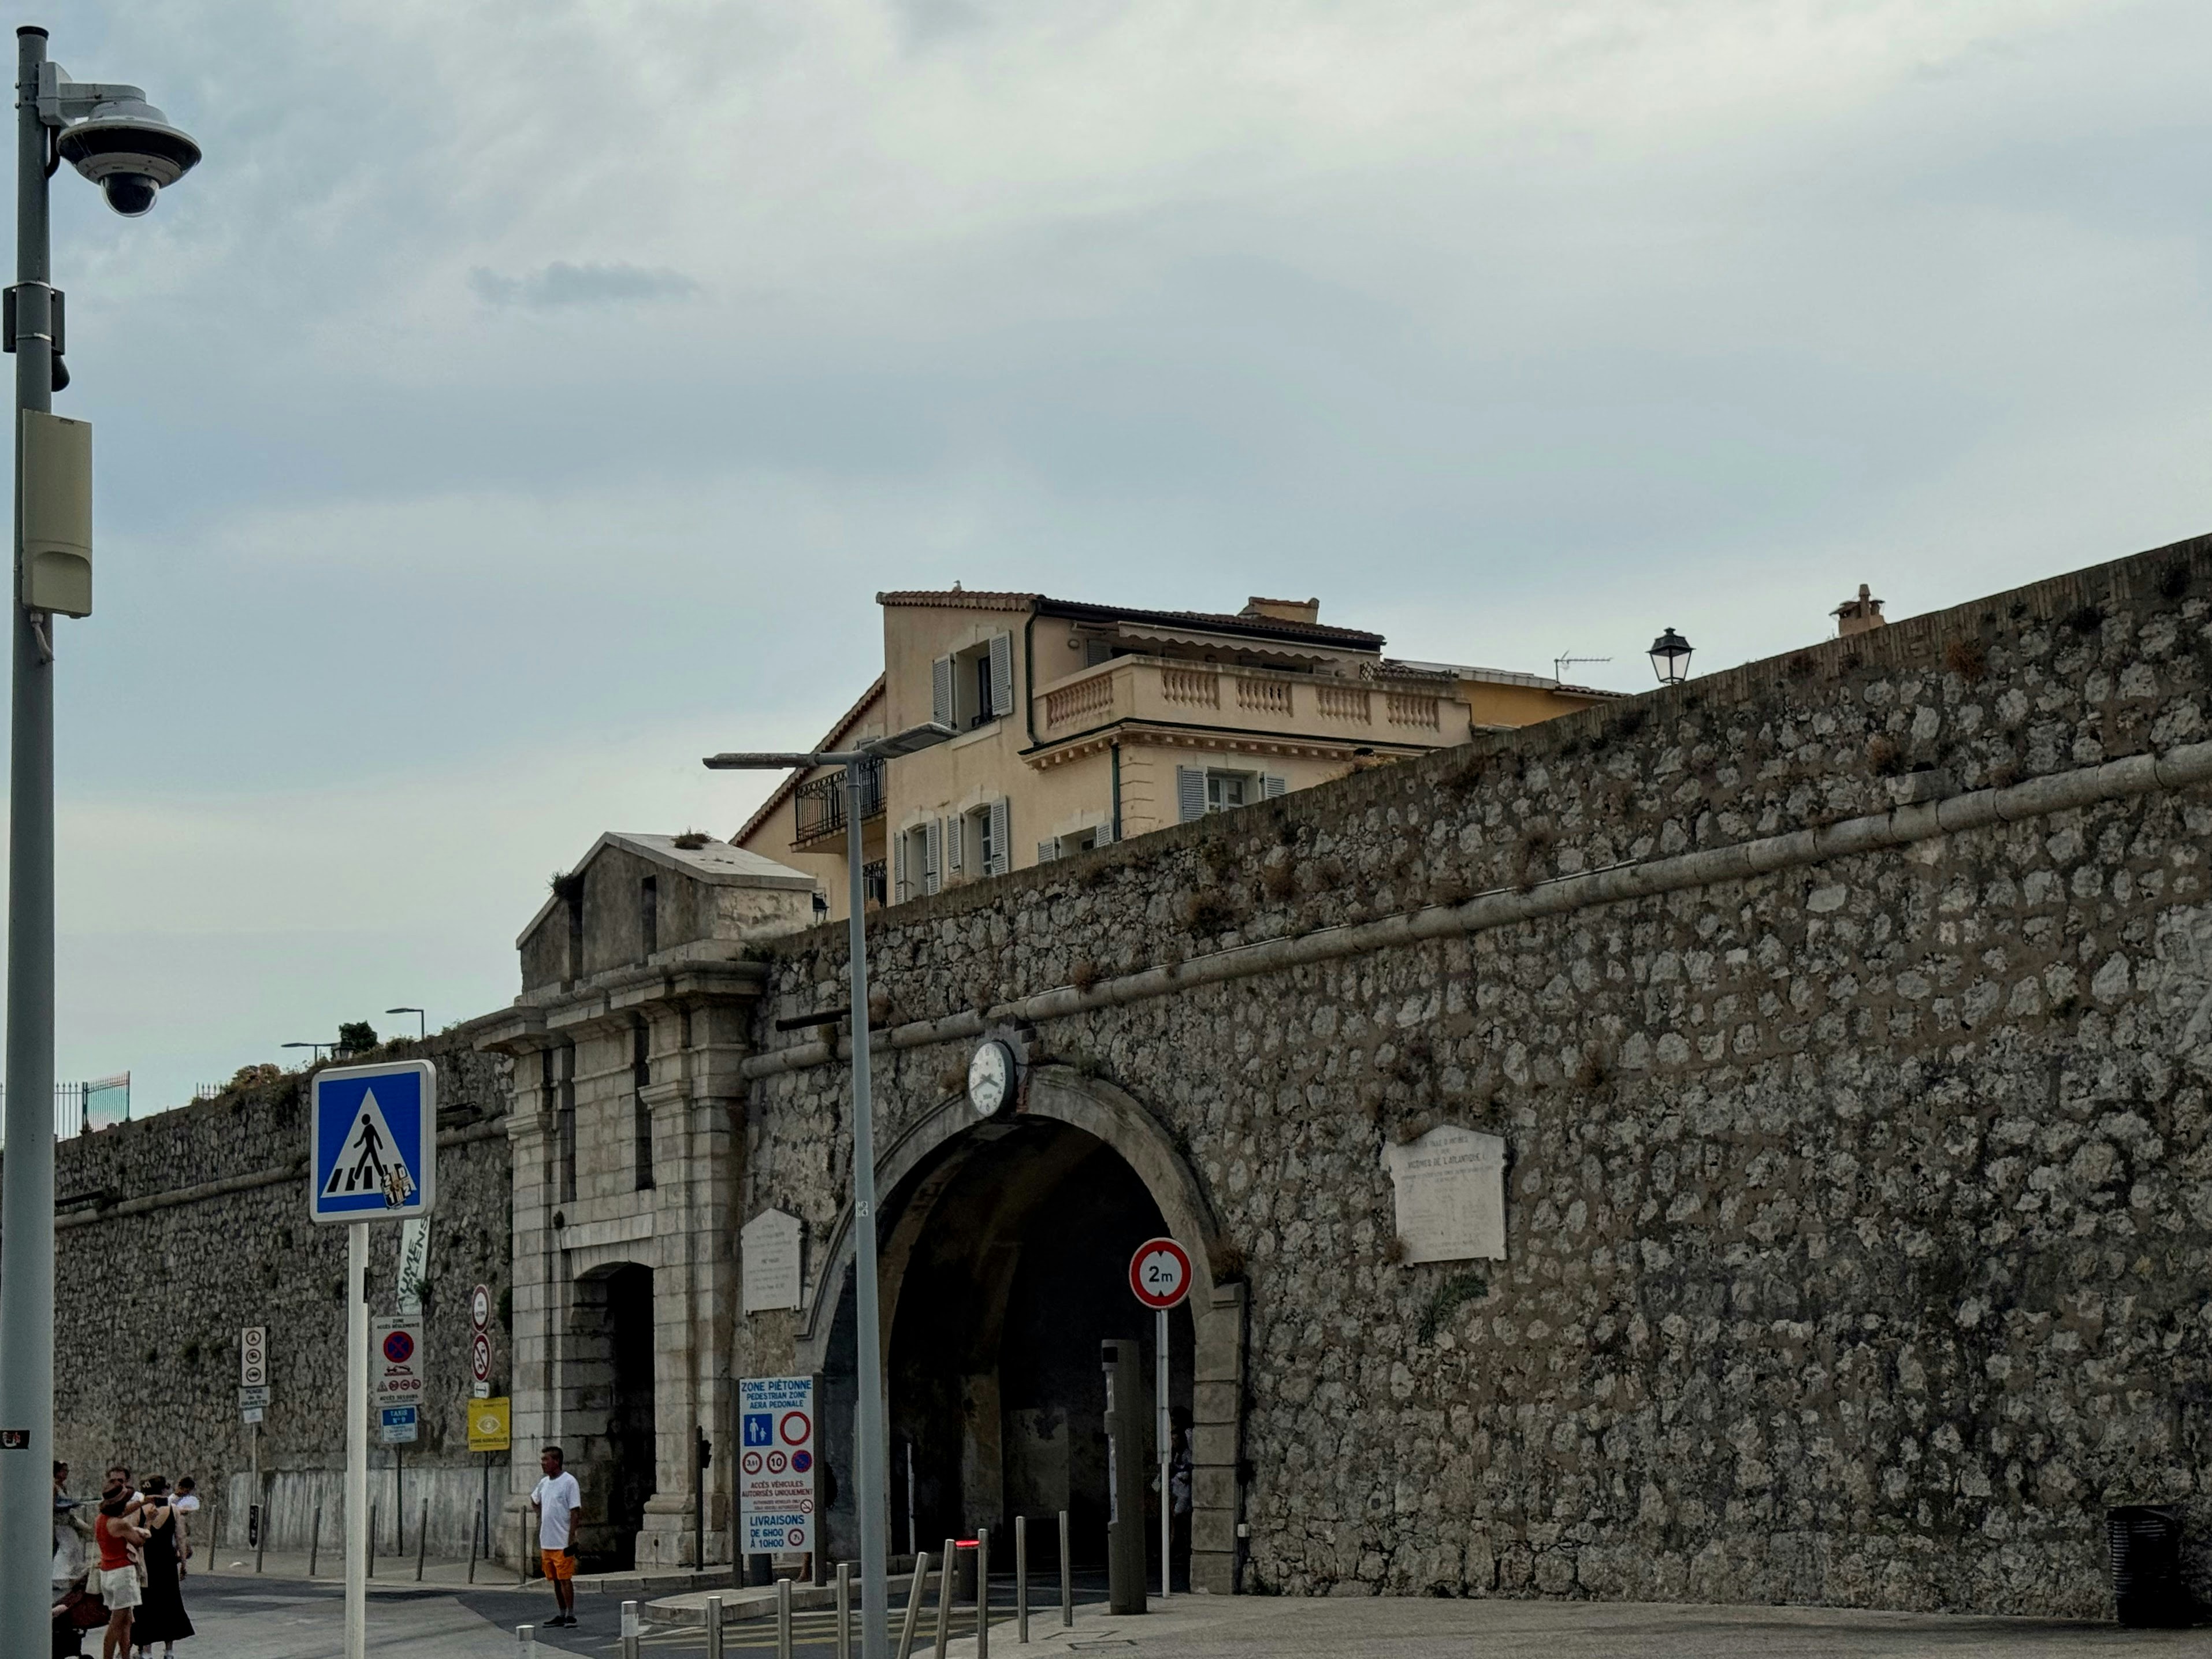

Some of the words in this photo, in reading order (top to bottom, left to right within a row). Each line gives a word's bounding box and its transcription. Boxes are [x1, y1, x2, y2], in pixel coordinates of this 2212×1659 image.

[998, 1057, 1002, 1067] 2
[1000, 1072, 1004, 1082] 3
[979, 1100, 983, 1110] 7
[986, 1103, 990, 1112] 6
[1149, 1266, 1173, 1282] 2m
[742, 1381, 765, 1392] ZONE
[746, 1392, 787, 1400] PEDESTRIAN
[789, 1390, 807, 1398] ZONE
[749, 1401, 767, 1409] AERA
[769, 1399, 804, 1408] PEDONALE
[771, 1457, 782, 1467] 10
[774, 1488, 813, 1496] UNIQUEMENT
[750, 1515, 805, 1526] LIVRAISONS
[750, 1528, 760, 1537] DE
[763, 1528, 783, 1537] 6H00
[750, 1537, 756, 1548] À
[759, 1539, 784, 1548] 10H00
